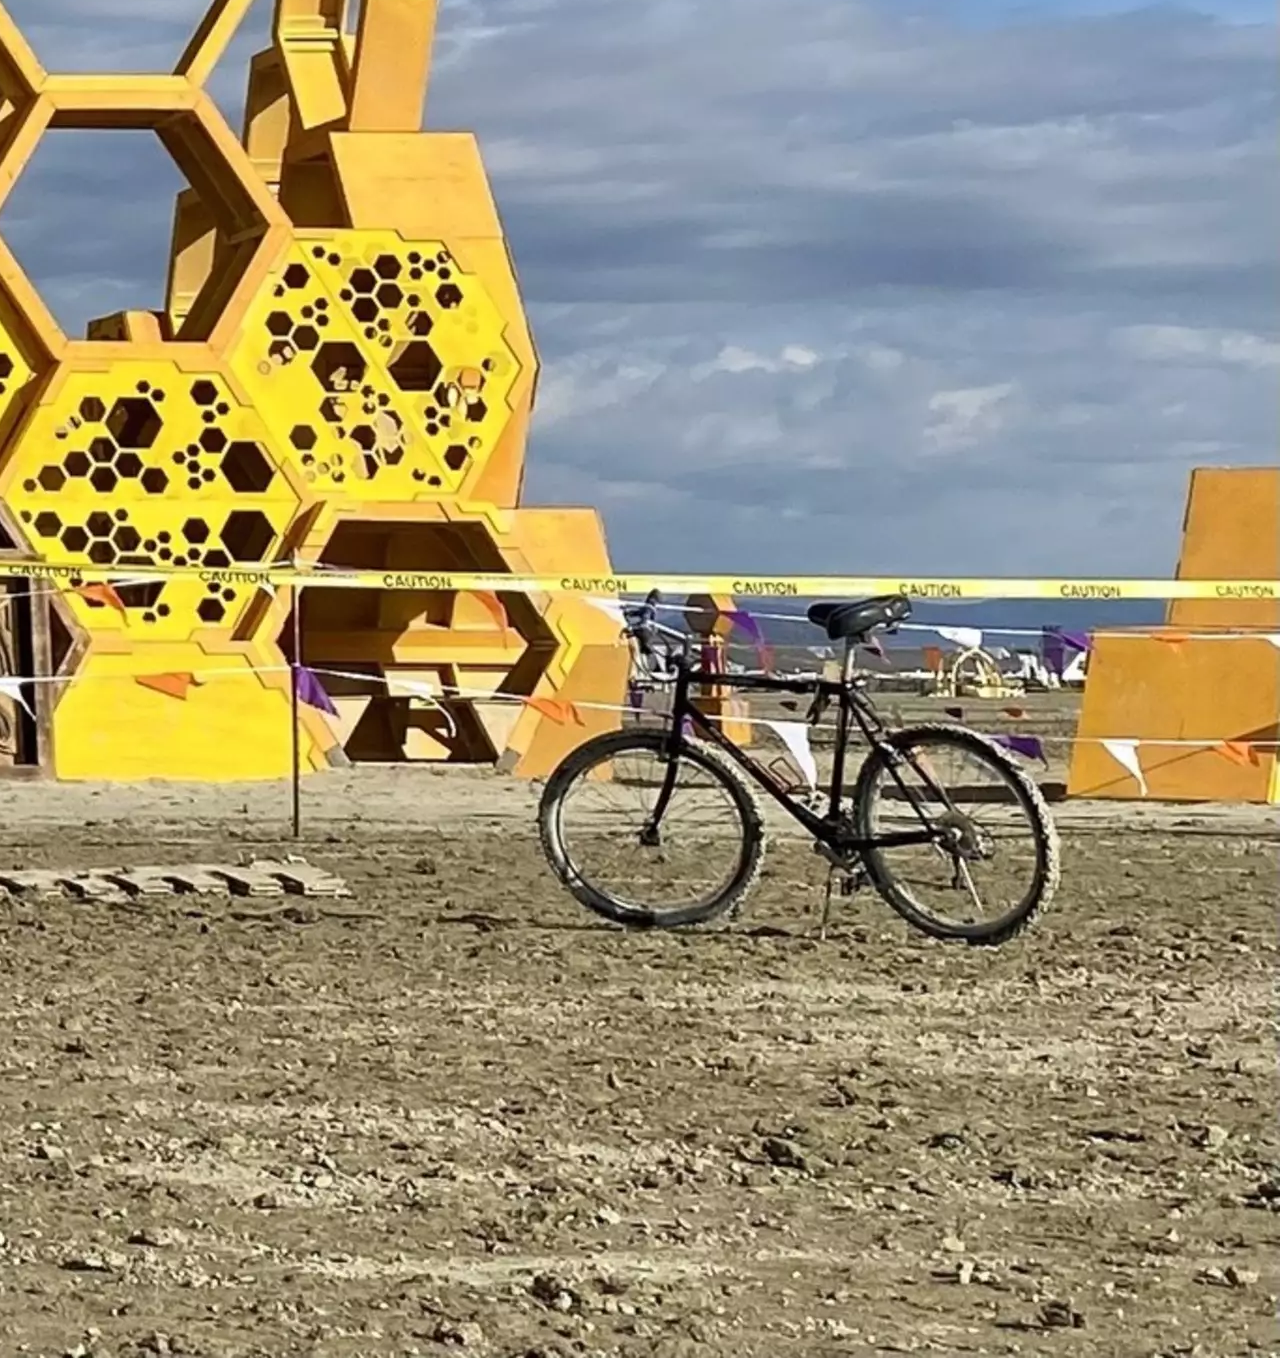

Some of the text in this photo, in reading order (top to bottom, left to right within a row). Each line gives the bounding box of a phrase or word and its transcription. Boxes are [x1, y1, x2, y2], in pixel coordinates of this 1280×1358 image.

[8, 564, 82, 579] CAUTION
[198, 570, 271, 584] CAUTION
[382, 574, 453, 589] CAUTION
[560, 577, 627, 592] CAUTION
[732, 581, 798, 596] CAUTION
[898, 583, 962, 597] CAUTION
[1060, 584, 1121, 598] CAUTION
[1215, 585, 1274, 598] CAUTION
